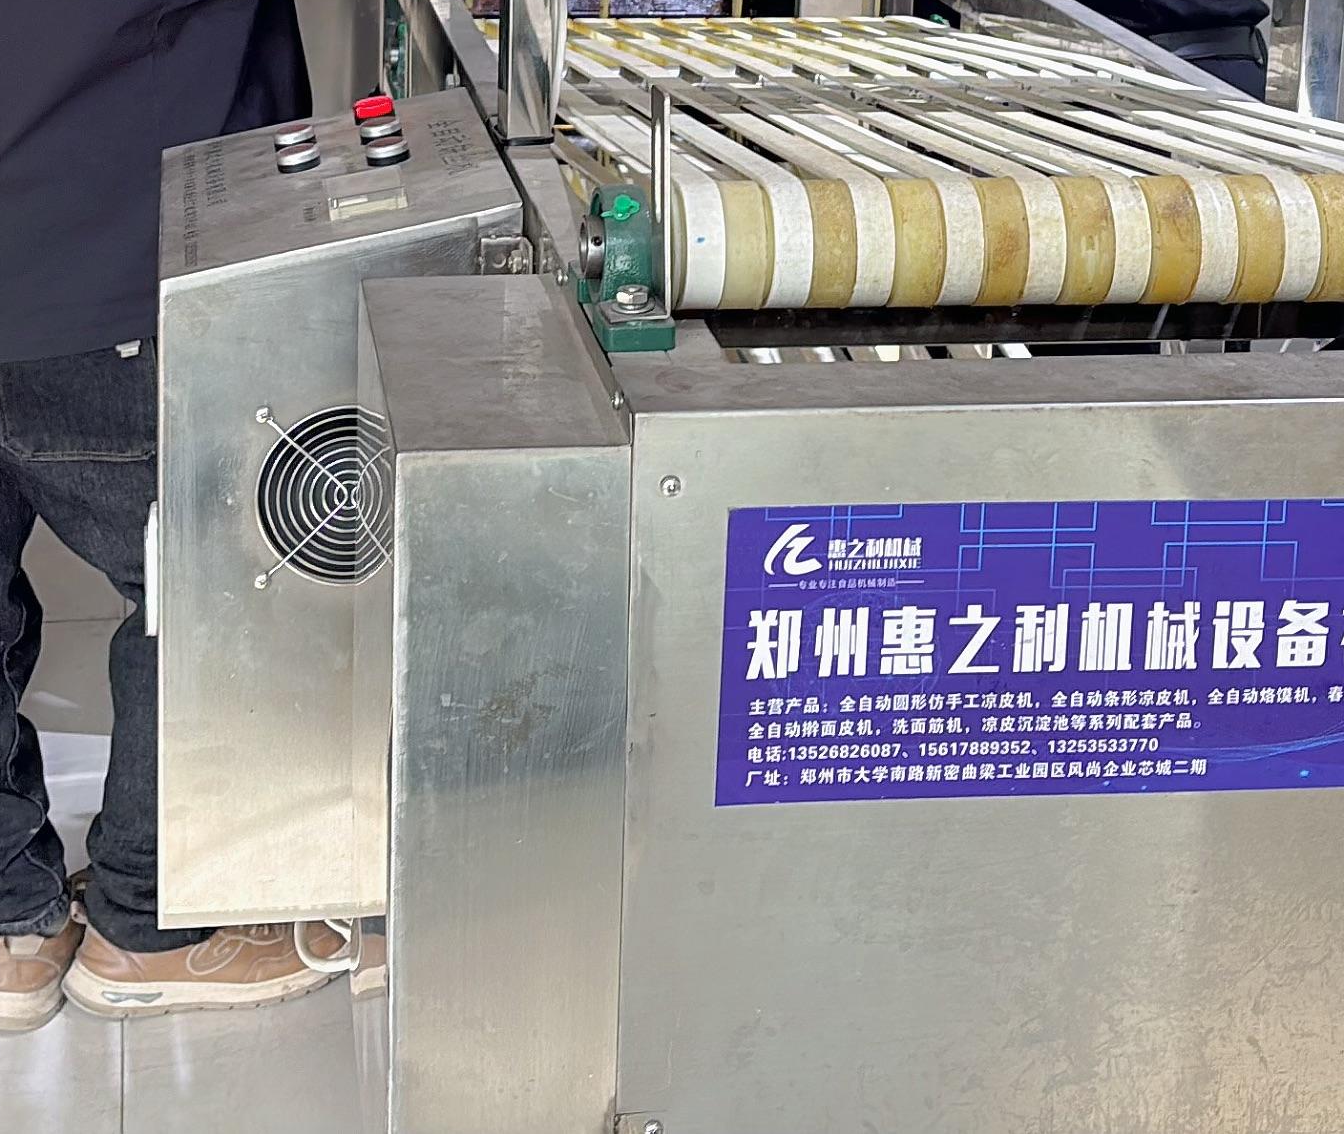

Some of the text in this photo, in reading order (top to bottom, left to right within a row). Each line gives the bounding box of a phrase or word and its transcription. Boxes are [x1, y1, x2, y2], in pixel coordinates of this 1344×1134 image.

[827, 537, 923, 559] 惠之利机械
[799, 577, 896, 590] 专业专注食品机械制造
